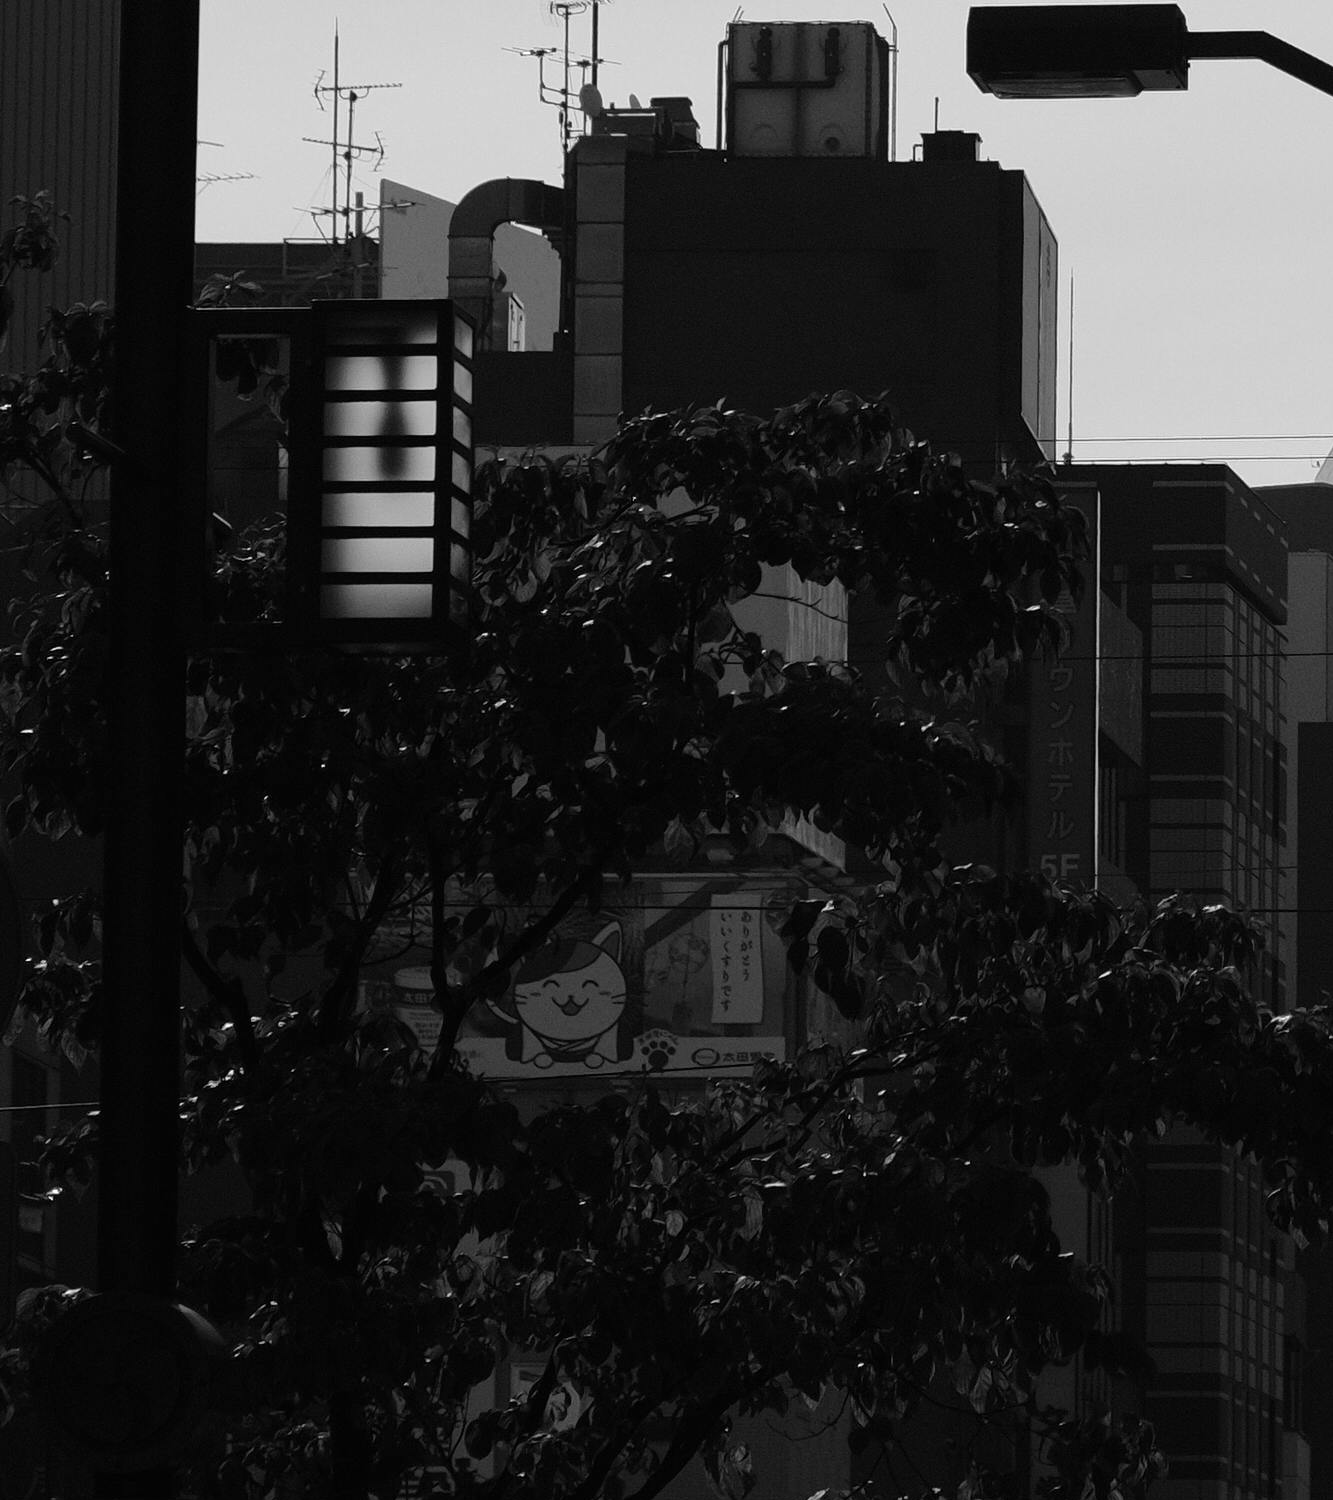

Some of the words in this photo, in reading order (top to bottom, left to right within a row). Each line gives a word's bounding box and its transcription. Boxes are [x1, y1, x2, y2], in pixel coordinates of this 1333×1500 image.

[1041, 852, 1081, 878] 5F
[720, 913, 732, 1012] いいくすりです
[740, 911, 753, 981] ありがとう
